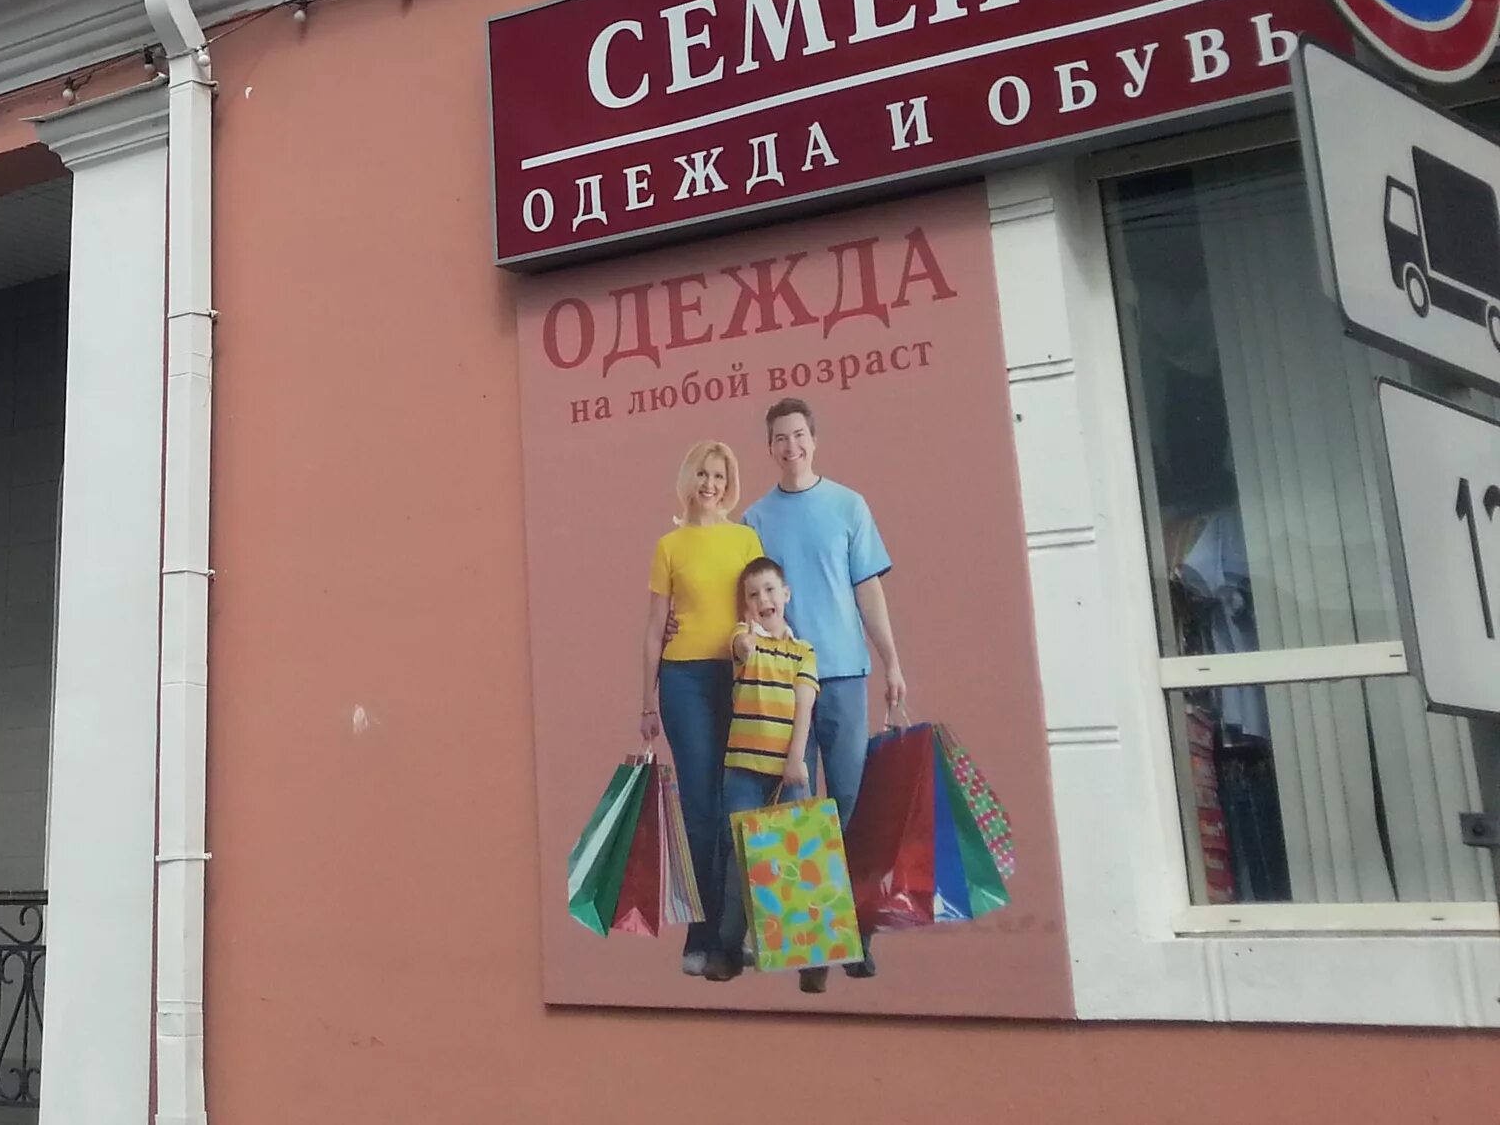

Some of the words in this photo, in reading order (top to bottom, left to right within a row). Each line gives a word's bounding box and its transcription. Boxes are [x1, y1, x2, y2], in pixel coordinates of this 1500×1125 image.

[522, 121, 840, 235] ОДЕЖДА
[886, 96, 932, 152] И
[988, 12, 1299, 126] ОБУВЬ
[542, 225, 958, 378] ОДЕЖДА
[570, 395, 613, 424] на
[627, 362, 750, 415] любой
[767, 340, 933, 391] возраст
[1455, 476, 1500, 640] 1
